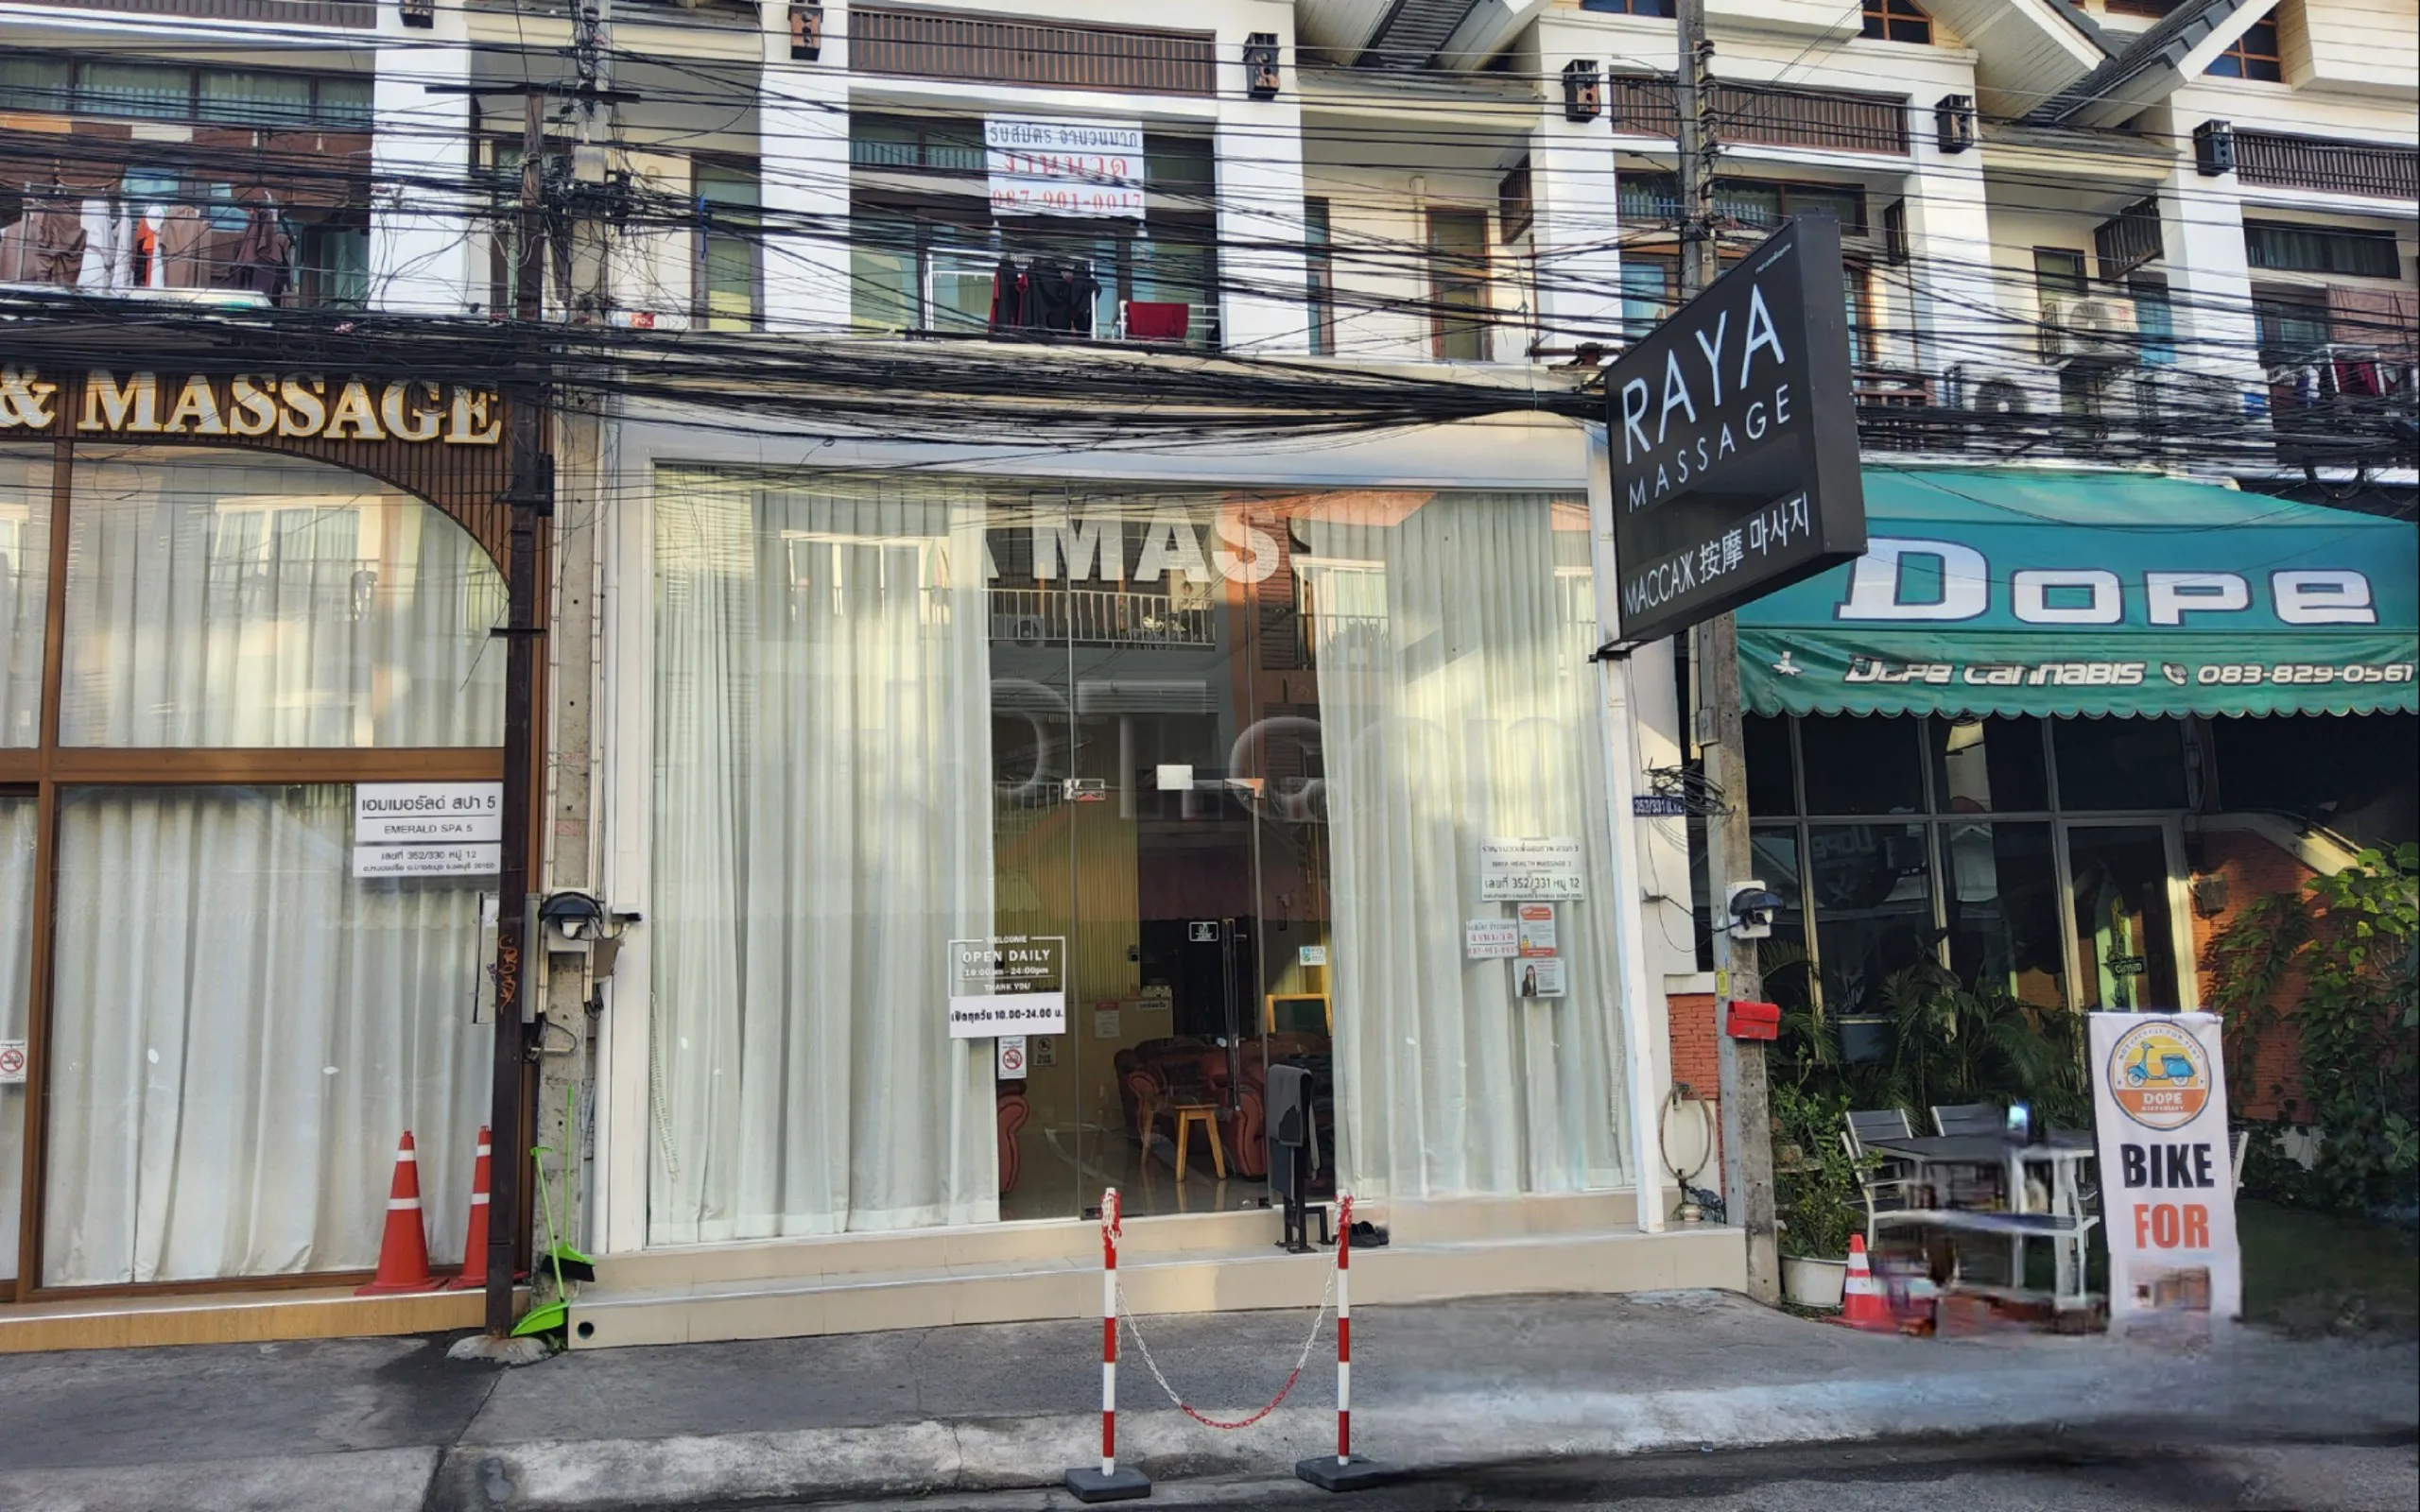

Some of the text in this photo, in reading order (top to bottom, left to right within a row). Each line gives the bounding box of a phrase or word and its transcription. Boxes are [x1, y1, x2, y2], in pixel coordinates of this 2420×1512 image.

[1621, 284, 1786, 465] RAYA
[78, 369, 503, 445] MASSAGE
[1628, 384, 1791, 513] MASSAGE
[1700, 529, 1744, 584] 按摩
[1750, 491, 1810, 557] 마사지
[2196, 662, 2414, 686] 083-829-0561
[453, 796, 480, 810] สปา
[487, 796, 496, 809] 5
[384, 824, 473, 834] EMERALD SPA 5
[466, 850, 477, 859] 12
[1512, 877, 1550, 889] 352/331
[1569, 877, 1580, 889] 12
[986, 935, 1028, 944] WELCOME
[962, 949, 1051, 963] OPEN DAILY
[984, 982, 1031, 992] THANK YOU
[994, 1007, 1052, 1021] 10.00-24.00
[2143, 1091, 2183, 1105] DOPE
[2120, 1143, 2215, 1188] BIKE
[2133, 1203, 2209, 1249] FOR
